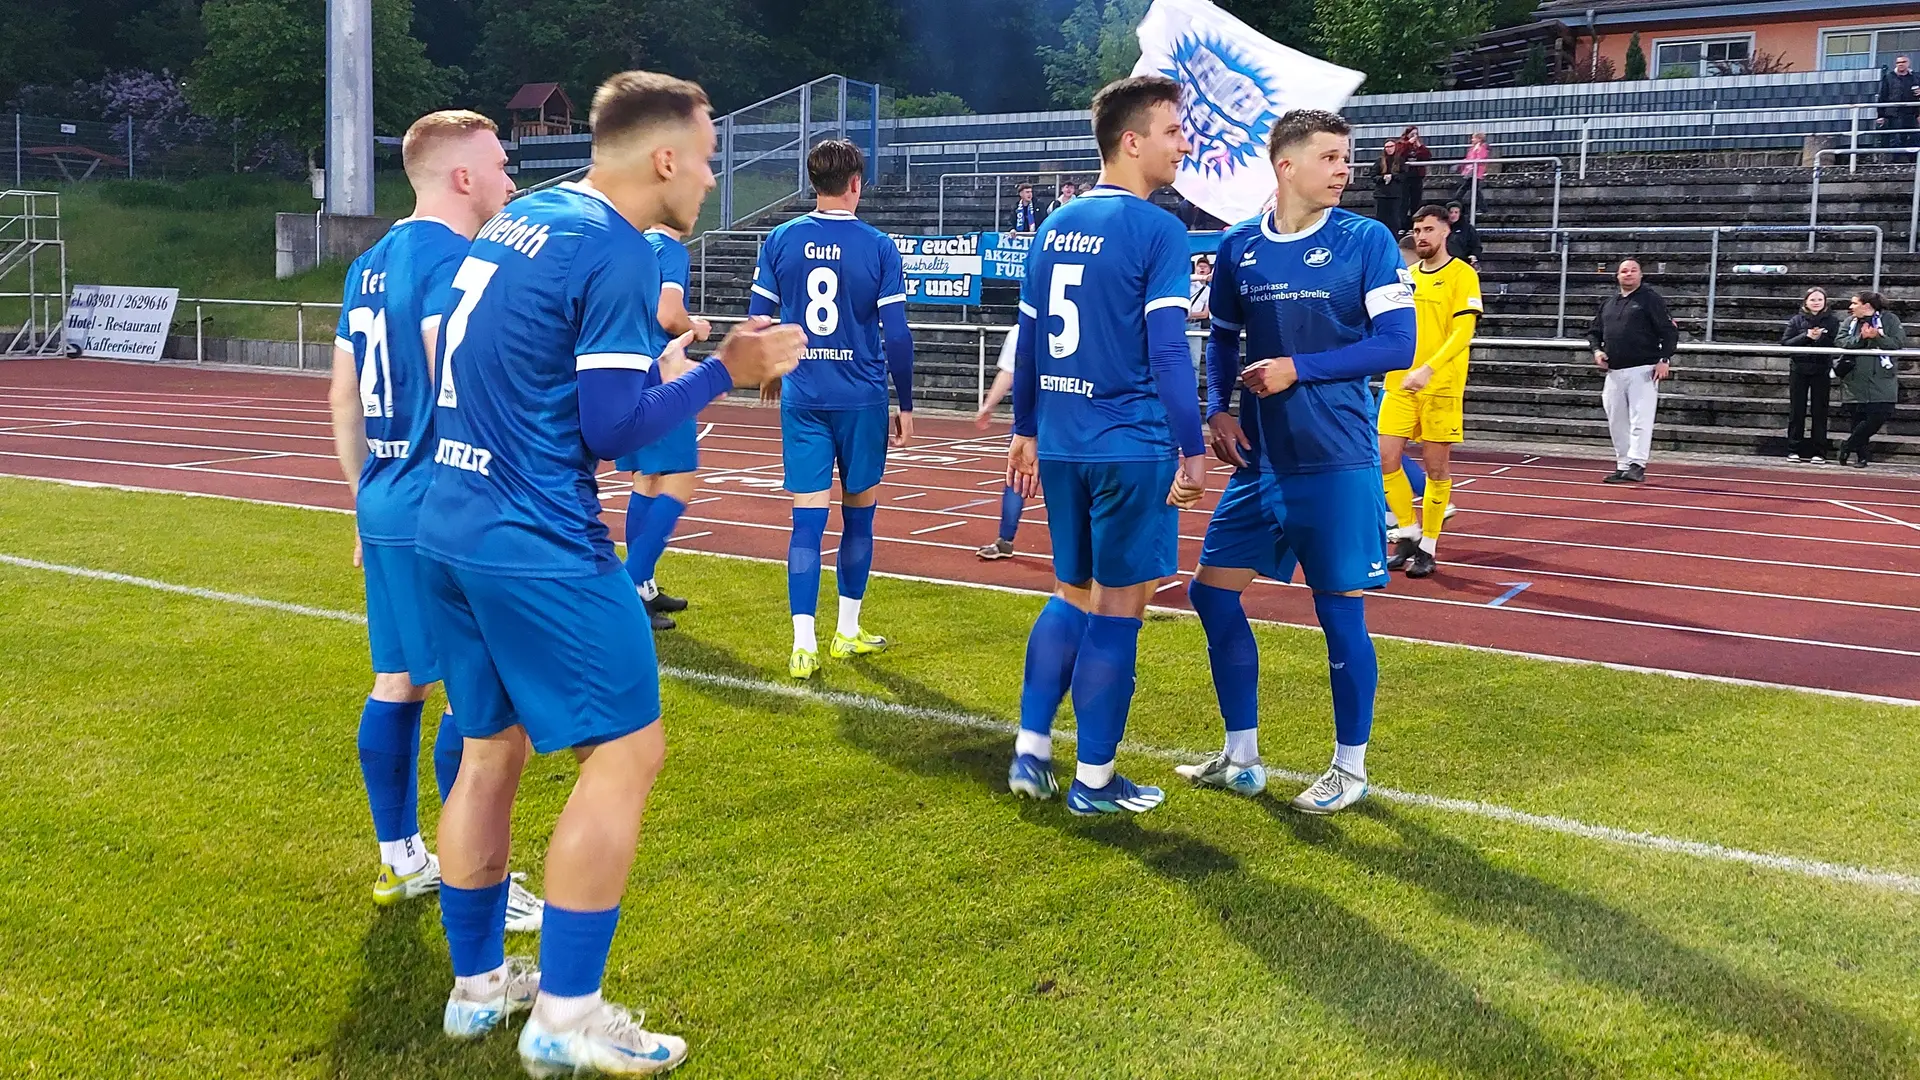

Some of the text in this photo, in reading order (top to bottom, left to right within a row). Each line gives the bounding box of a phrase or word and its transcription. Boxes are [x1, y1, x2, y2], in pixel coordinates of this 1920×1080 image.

[477, 212, 550, 259] liefoth
[888, 233, 978, 255] ür euch!
[1043, 230, 1105, 255] Petters
[804, 241, 841, 260] Guth
[984, 249, 1029, 263] AKZEP
[902, 257, 949, 275] eustrelitz
[925, 274, 971, 296] uns!
[1249, 282, 1289, 294] Sparkasse
[71, 293, 83, 307] el.
[86, 293, 116, 310] 03981
[124, 295, 169, 310] 2629646
[805, 266, 839, 336] 8
[1250, 289, 1331, 303] Mecklenburg-Strelitz
[1048, 263, 1085, 359] 5
[68, 314, 97, 330] Hotel
[105, 316, 162, 333] Restaurant
[437, 255, 499, 409] 7
[84, 336, 157, 355] Kaffeerösterei
